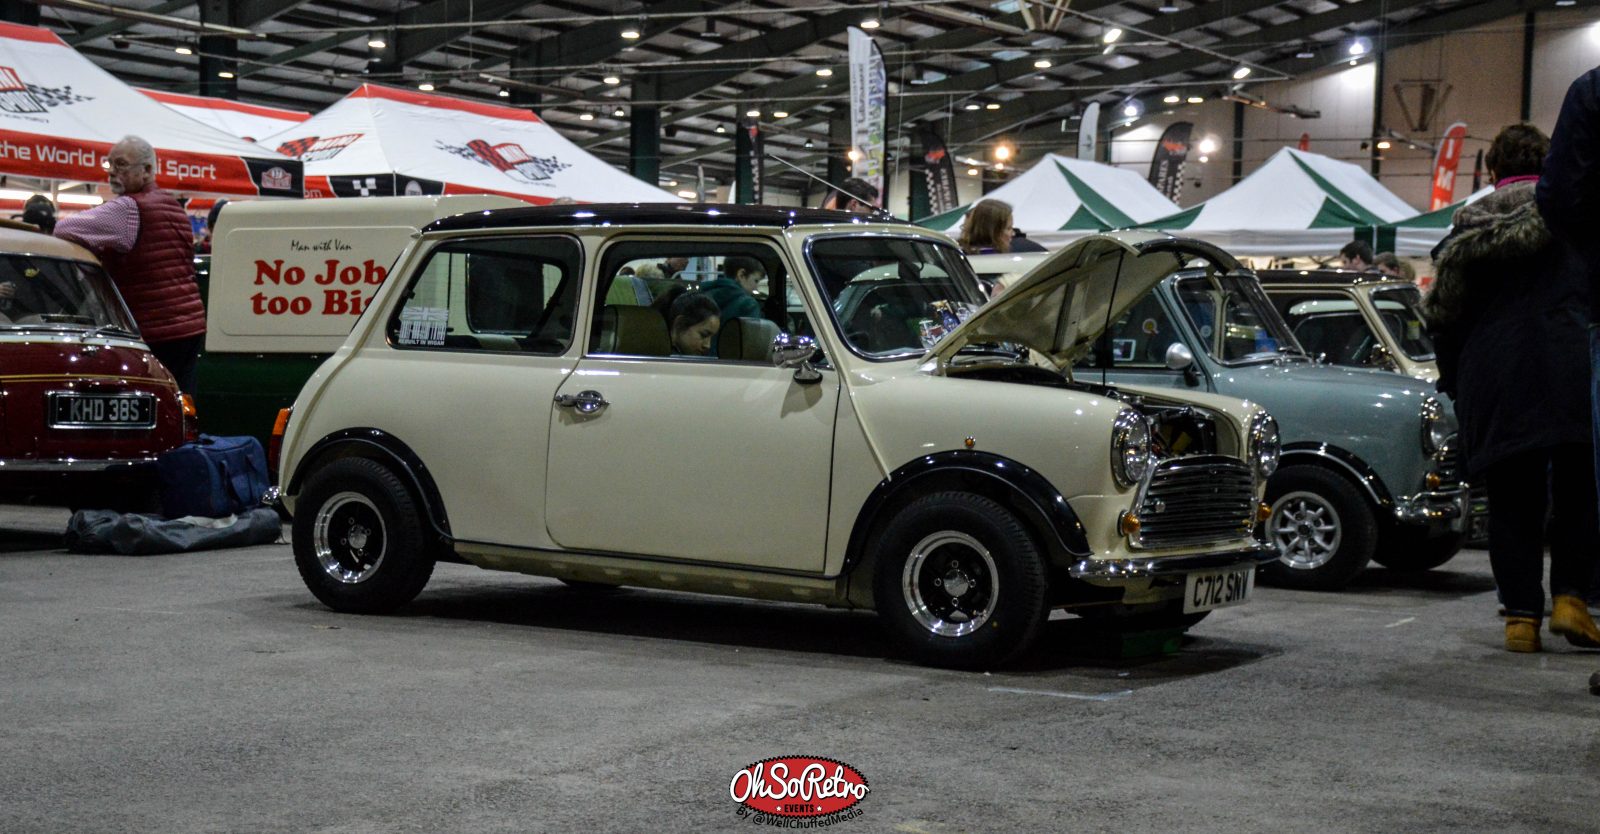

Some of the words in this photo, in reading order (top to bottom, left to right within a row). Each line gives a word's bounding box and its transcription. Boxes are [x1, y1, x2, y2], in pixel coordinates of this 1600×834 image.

[36, 144, 96, 167] World
[166, 159, 217, 181] Sport
[291, 240, 310, 251] Man
[312, 240, 332, 252] with
[334, 239, 352, 250] Van
[254, 259, 306, 286] No
[314, 259, 387, 286] Job
[250, 291, 312, 316] too
[70, 399, 104, 421] KHD
[109, 399, 139, 421] 38S
[1193, 574, 1224, 607] C712
[1225, 571, 1250, 602] SNV
